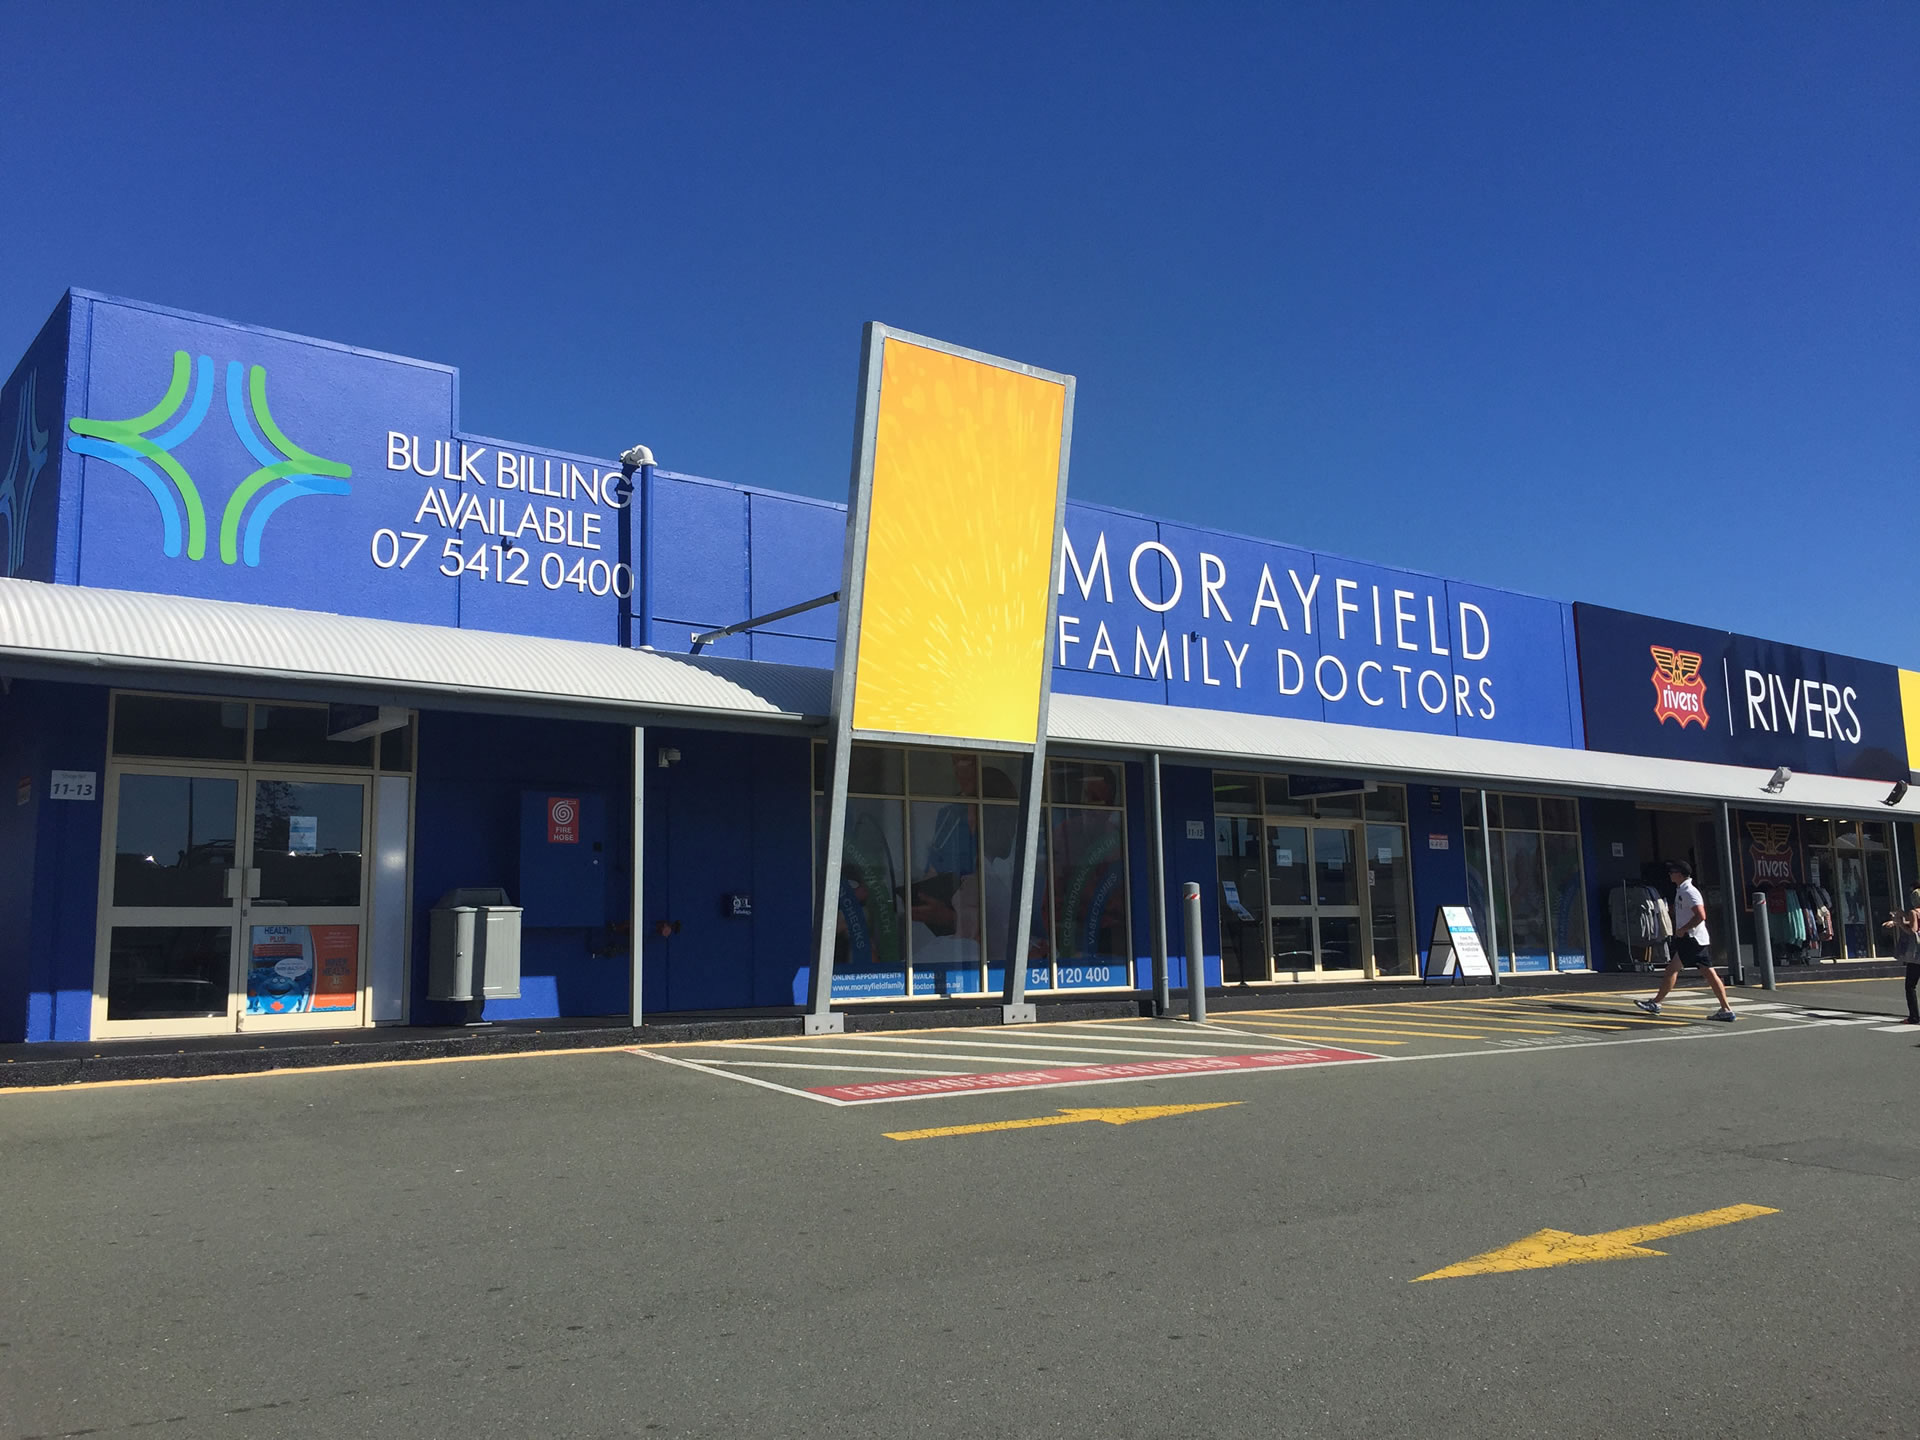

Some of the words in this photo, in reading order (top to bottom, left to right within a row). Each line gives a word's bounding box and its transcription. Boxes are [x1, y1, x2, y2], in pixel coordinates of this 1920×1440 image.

[387, 431, 486, 486] BULK
[497, 451, 633, 509] BILLING
[414, 486, 601, 550] AVAILABLE
[371, 528, 428, 569] 07
[439, 538, 529, 586] 5412
[541, 552, 634, 599] 0400
[1058, 527, 1490, 660] MORAYFIELD
[1058, 615, 1249, 690] FAMILY
[1278, 648, 1496, 721] DOCTORS
[1663, 684, 1699, 712] rivers
[1745, 669, 1862, 744] RIVERS
[54, 783, 93, 796] 11-13
[553, 834, 575, 842] HOSE
[555, 826, 572, 834] FIRE
[1757, 855, 1790, 877] rivers
[264, 926, 292, 935] HEALTH
[832, 974, 855, 982] ONLINE
[855, 972, 902, 981] APPOINTMENTS
[1085, 966, 1110, 983] 400
[834, 1072, 1061, 1097] EMERGENCY
[1074, 1059, 1241, 1077] VEHICLES
